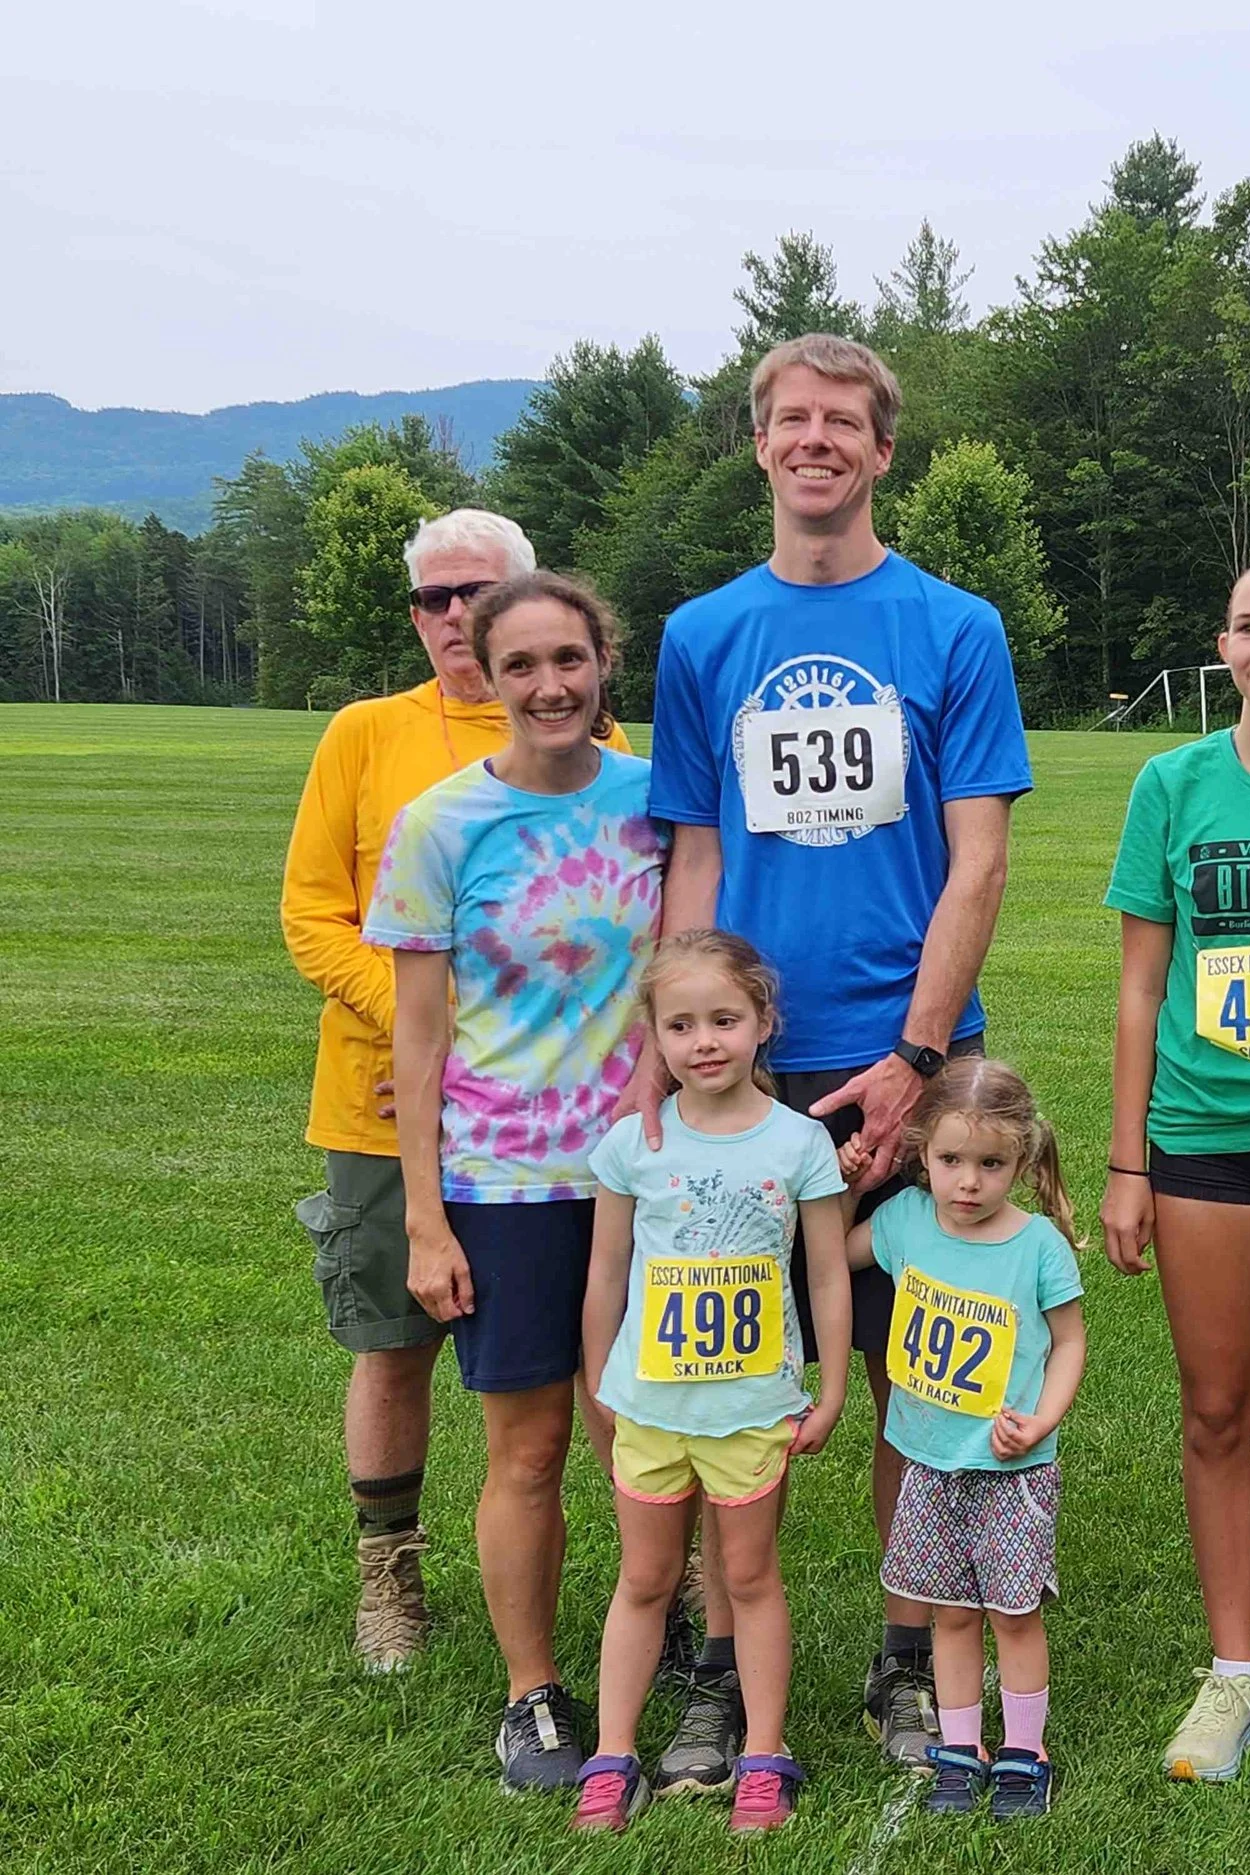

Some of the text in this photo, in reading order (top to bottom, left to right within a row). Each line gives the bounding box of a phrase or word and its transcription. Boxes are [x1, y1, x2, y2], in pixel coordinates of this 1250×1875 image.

[771, 727, 874, 796] 539
[787, 808, 864, 825] 802 TIMING
[1208, 955, 1245, 976] ESSEX
[651, 1262, 773, 1286] ESSEX INVITATIONAL
[906, 1274, 1009, 1328] ESSEX INVITATIONAL
[657, 1288, 761, 1358] 498
[903, 1305, 992, 1394] 492
[674, 1360, 745, 1377] SKI RACK
[907, 1374, 962, 1407] SKI RACK
